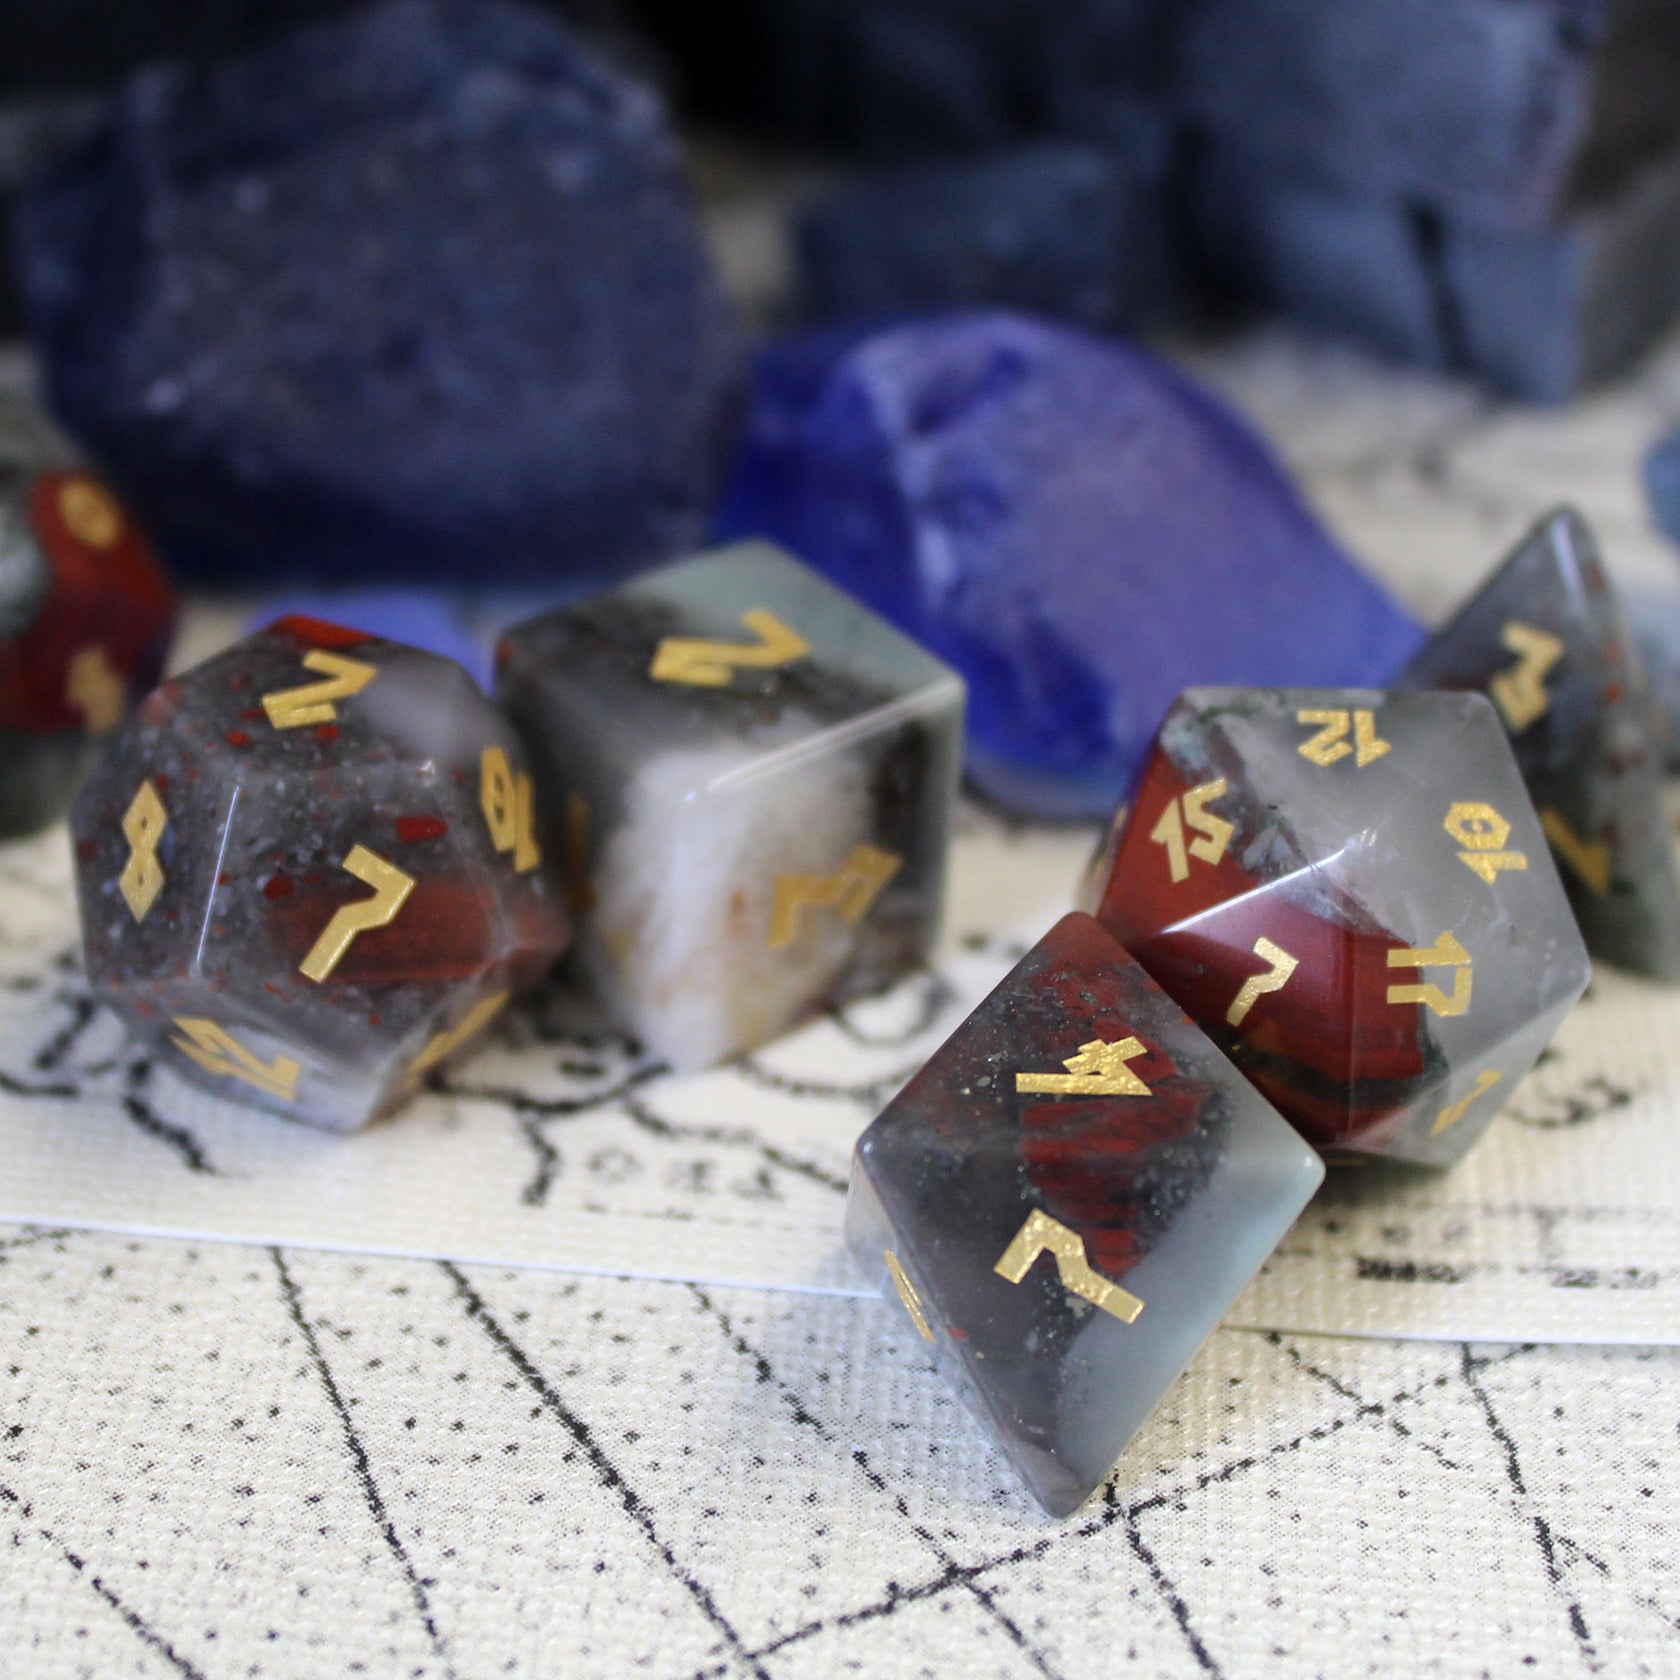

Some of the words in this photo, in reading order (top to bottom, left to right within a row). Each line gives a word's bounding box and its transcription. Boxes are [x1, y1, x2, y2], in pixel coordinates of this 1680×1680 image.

[262, 650, 377, 729] 2
[647, 609, 809, 686] 2
[1296, 709, 1392, 768] 12
[118, 780, 168, 924] 8
[480, 746, 540, 872] 10
[1151, 777, 1235, 883] 15
[1444, 802, 1529, 886] 10
[299, 842, 416, 984] 7
[1226, 936, 1300, 1027] 7
[1386, 930, 1474, 1018] 17
[993, 1208, 1146, 1325] 7
